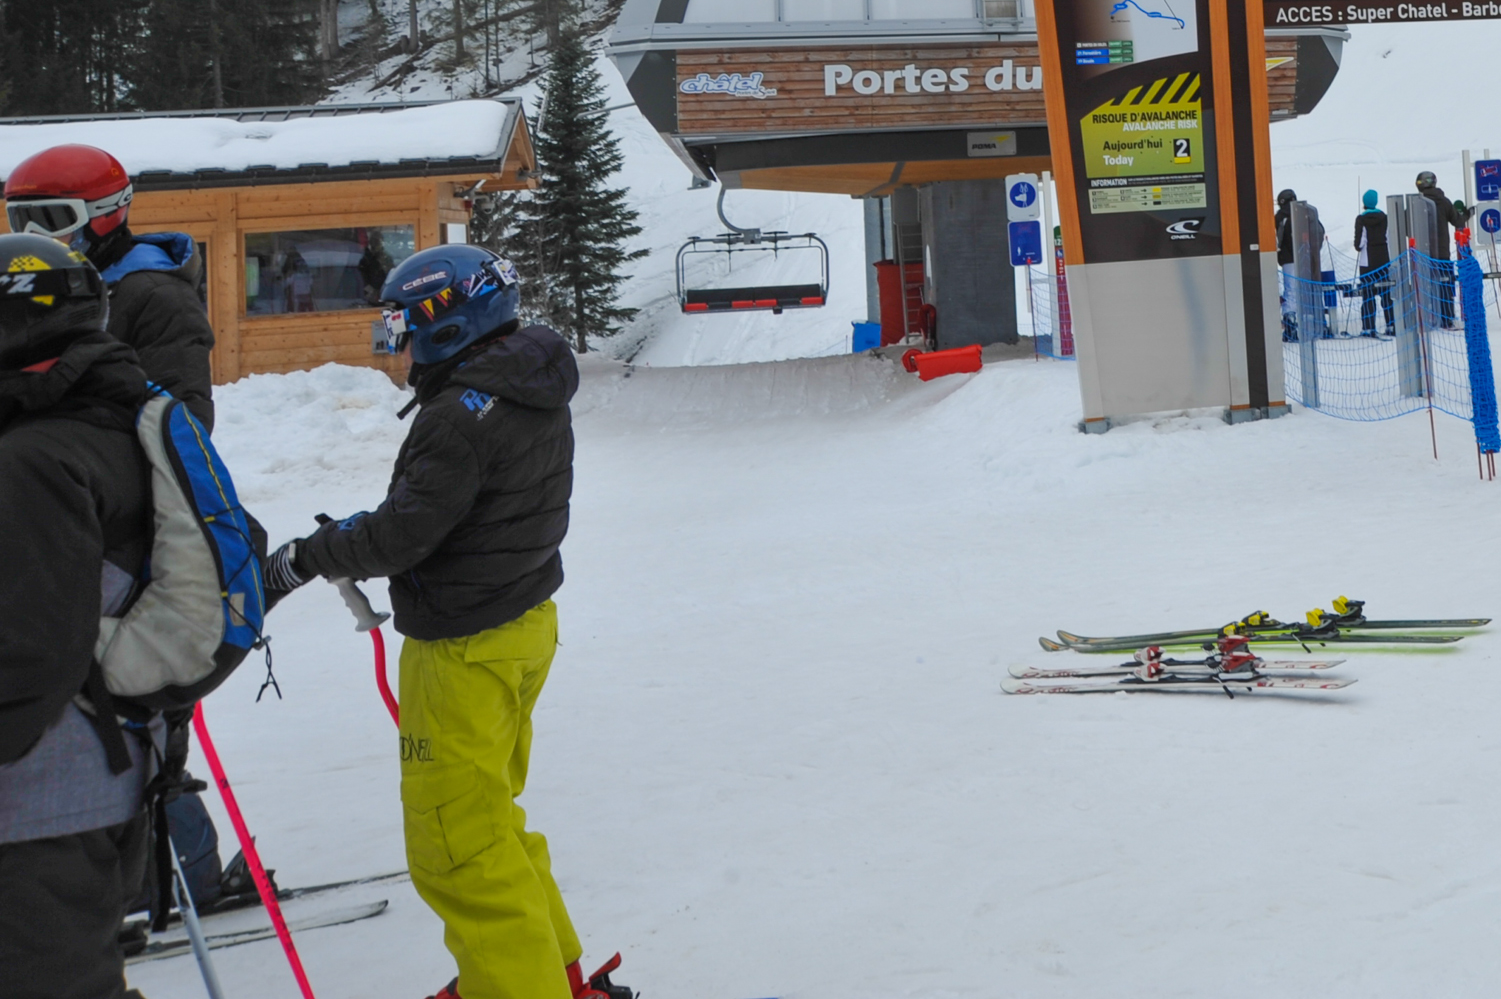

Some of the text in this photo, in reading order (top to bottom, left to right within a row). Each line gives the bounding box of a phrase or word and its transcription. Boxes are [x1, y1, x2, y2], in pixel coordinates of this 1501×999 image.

[1276, 7, 1334, 24] ACCES
[1346, 5, 1394, 24] Super
[1398, 3, 1448, 20] Chatel
[681, 73, 763, 93] châtel
[824, 60, 1042, 96] Portes du
[1092, 110, 1198, 124] RISQUE D'AVALANCHE
[1122, 119, 1198, 132] AVALANCHE RISK
[1103, 139, 1163, 152] Aujourd'hui
[1175, 138, 1188, 157] 2
[1102, 155, 1134, 166] Today
[1091, 178, 1128, 187] INFORMATION
